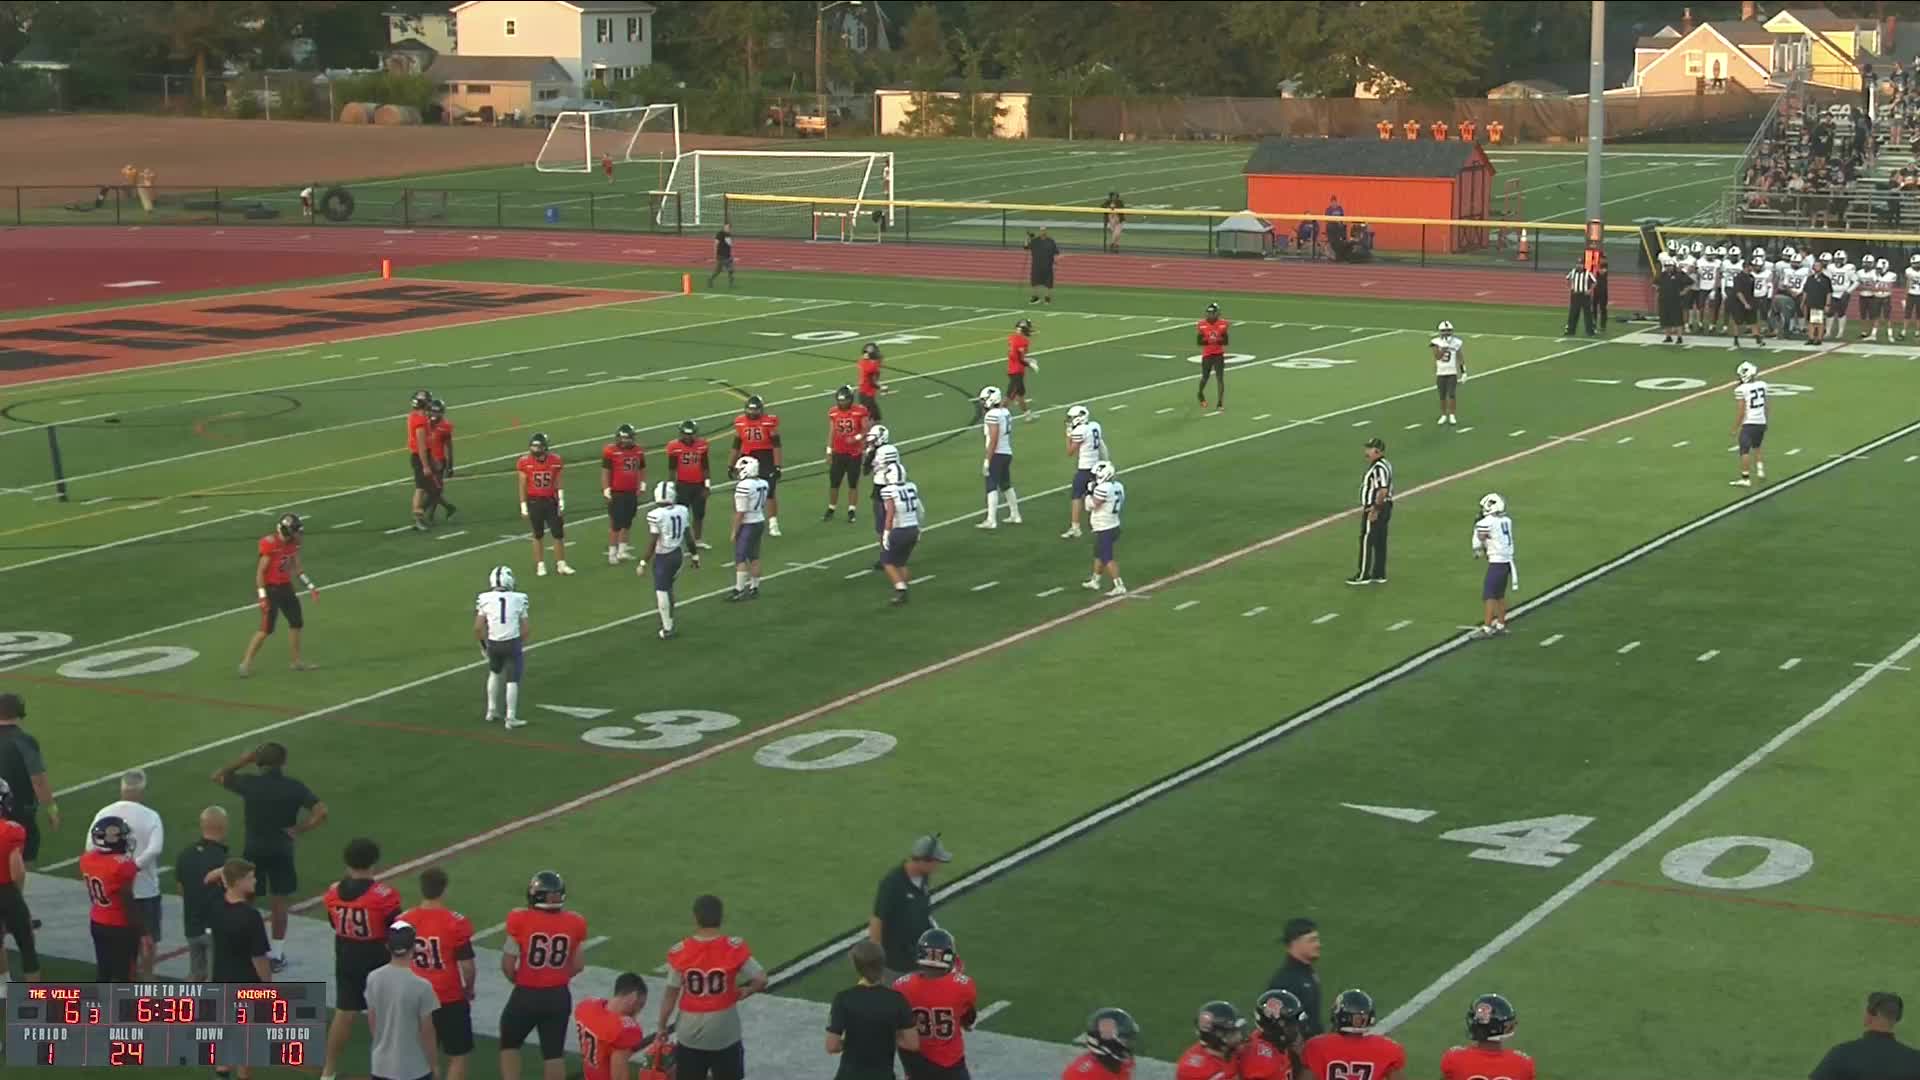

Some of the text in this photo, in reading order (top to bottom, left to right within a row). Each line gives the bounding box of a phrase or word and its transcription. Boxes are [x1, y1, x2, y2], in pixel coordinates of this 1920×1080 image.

[1749, 387, 1767, 409] 23
[533, 472, 551, 489] 55
[899, 489, 918, 514] 42
[670, 514, 682, 540] 11
[1500, 520, 1511, 547] 4
[499, 597, 507, 624] 1
[581, 709, 898, 770] 30
[1438, 813, 1815, 890] 40
[335, 904, 370, 939] 79
[527, 931, 570, 969] 68
